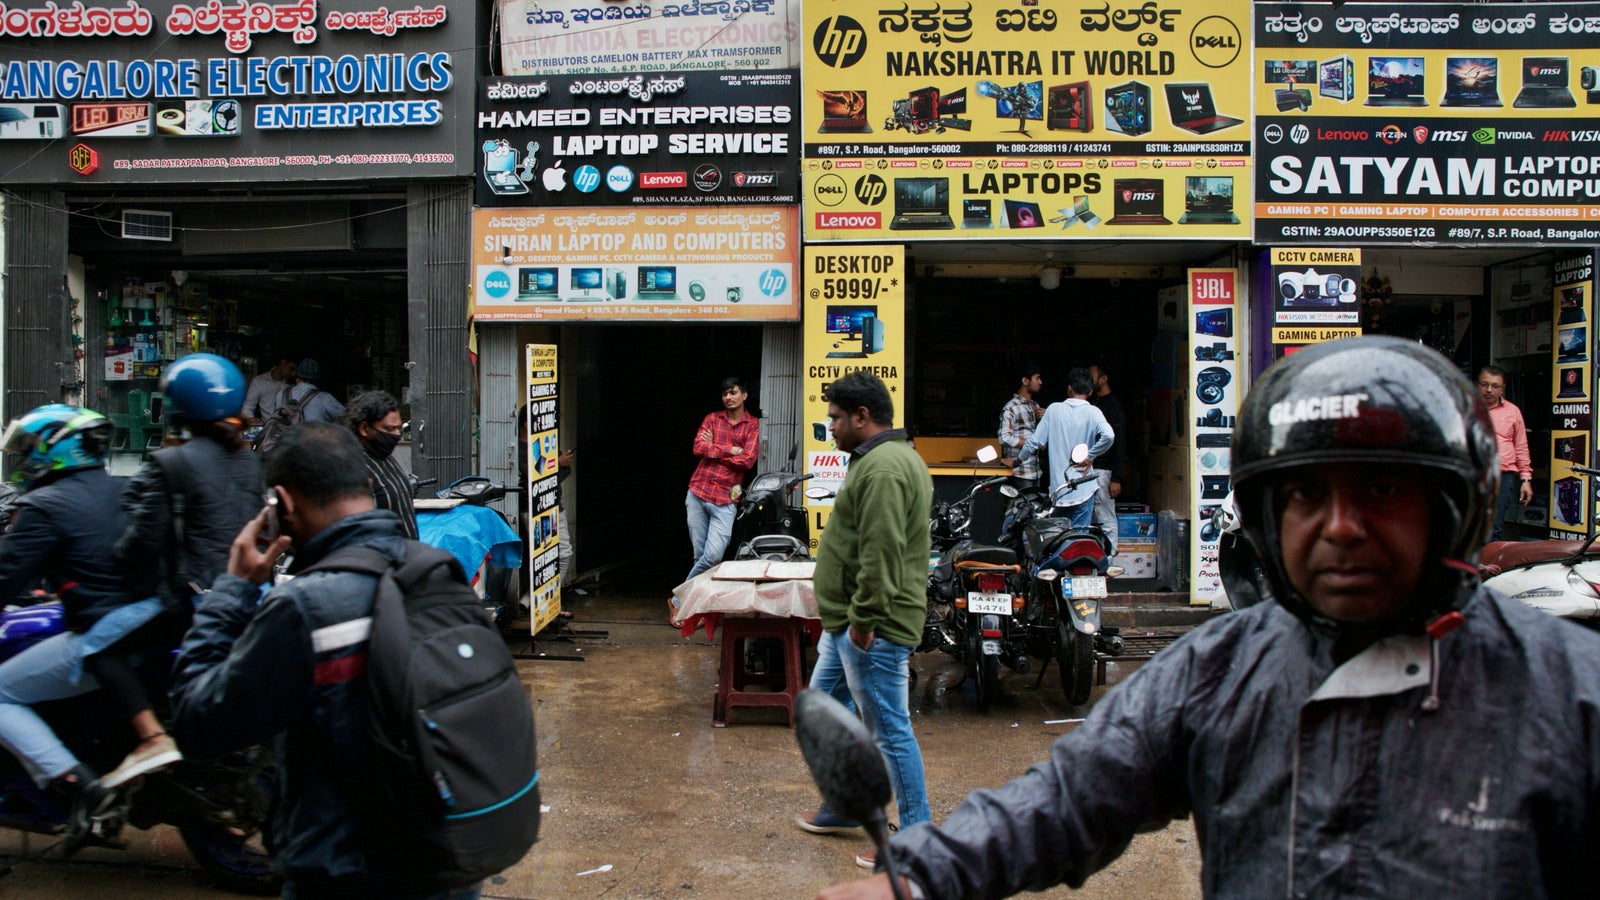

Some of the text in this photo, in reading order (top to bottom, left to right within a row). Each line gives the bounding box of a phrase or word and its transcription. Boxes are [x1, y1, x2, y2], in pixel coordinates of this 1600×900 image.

[0, 1, 153, 36] ಂಗಳೂರು
[565, 28, 629, 53] INDIA
[636, 21, 798, 50] ELECTRONICS
[816, 15, 866, 68] hp
[1195, 35, 1236, 48] DELL
[521, 56, 589, 69] DISTRIBUTORS
[591, 53, 640, 65] CAMELION
[641, 50, 683, 62] BATTERY
[687, 49, 708, 60] MAX
[886, 50, 1175, 77] NAKSHATRA IT WORLD
[0, 53, 452, 99] ANGALORE ELECTRONICS
[83, 110, 109, 126] LED
[255, 101, 443, 129] ENTERPRISES
[478, 104, 791, 129] HAMEED ENTERPRISES
[1317, 128, 1369, 141] Lenovo
[1431, 130, 1469, 142] msi
[1542, 130, 1600, 142] HIKVISI
[553, 132, 789, 156] LAPTOP SERVICE
[863, 145, 885, 154] Road,
[202, 157, 229, 168] ROAD,
[230, 155, 280, 167] BANGALORE
[644, 175, 683, 185] Lenovo
[746, 174, 773, 184] msi
[1269, 155, 1496, 197] SATYAM
[818, 173, 1101, 206] DELL hp LAPTOPS
[1132, 192, 1155, 202] msi
[1267, 206, 1311, 215] GAMING
[1314, 206, 1329, 215] PC
[1339, 206, 1383, 215] GAMING
[1386, 206, 1429, 216] LAPTOP
[1439, 207, 1499, 217] COMPUTER
[1502, 207, 1579, 217] ACCESSORIES
[820, 216, 877, 228] Lenovo
[1281, 226, 1321, 237] GSTIN:
[1487, 228, 1508, 238] S.P.
[1510, 227, 1544, 239] Road,
[1547, 227, 1600, 240] Bangalor
[484, 232, 786, 253] SIMRAN LAPTOP AND COMPUTERS
[565, 254, 598, 262] GAMING
[613, 254, 634, 262] CCTV
[677, 252, 731, 261] NETWORKING
[732, 252, 775, 260] PRODUCTS
[815, 255, 894, 274] DESKTOP
[1278, 252, 1355, 262] CCTV CAMERA
[1554, 254, 1593, 271] GAMING
[1554, 268, 1592, 284] LAPTOP
[1196, 278, 1231, 299] JBL
[1278, 331, 1317, 340] GAMING
[809, 365, 840, 379] CCTV
[1268, 392, 1370, 426] GLACIER
[1552, 404, 1590, 415] GAMING
[1564, 418, 1578, 429] PC
